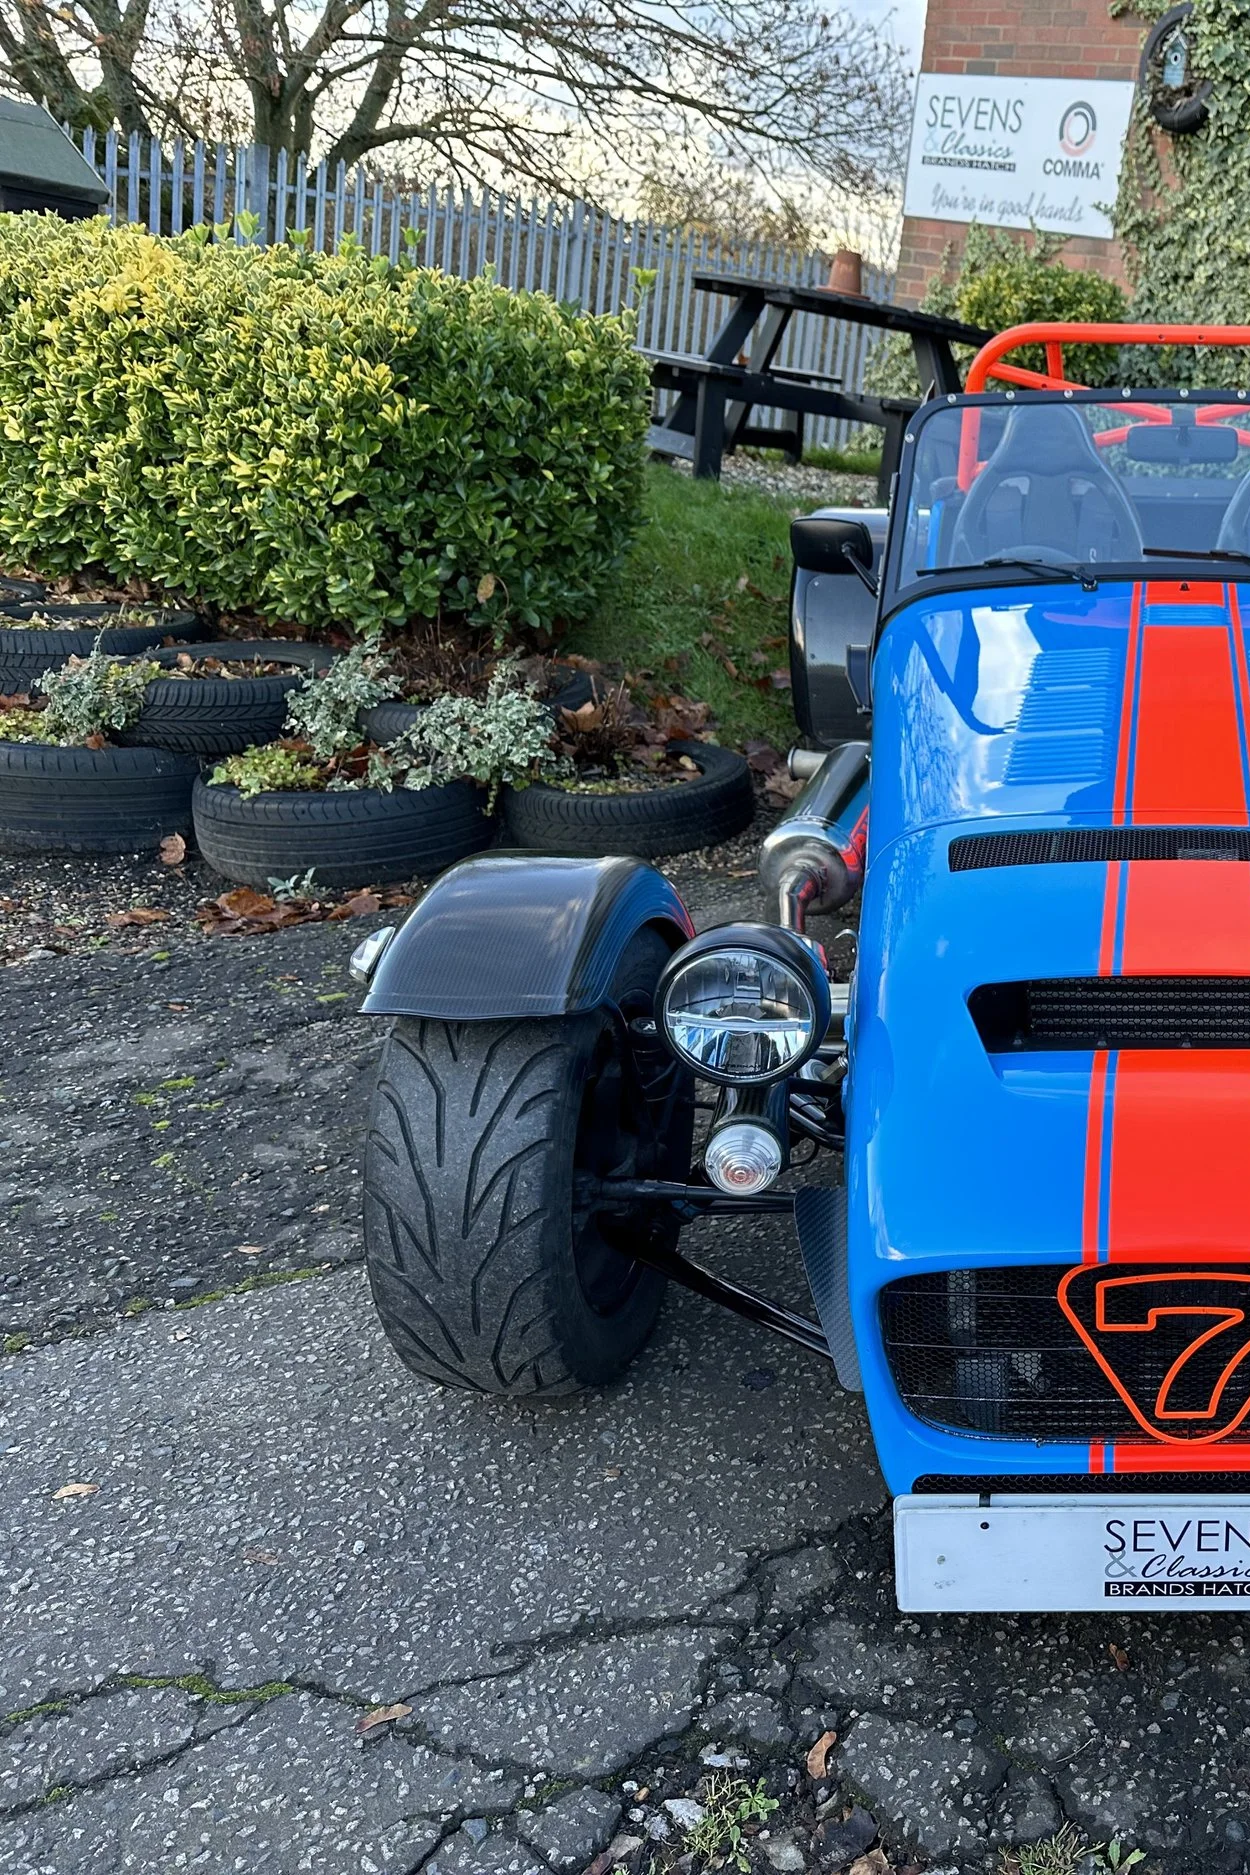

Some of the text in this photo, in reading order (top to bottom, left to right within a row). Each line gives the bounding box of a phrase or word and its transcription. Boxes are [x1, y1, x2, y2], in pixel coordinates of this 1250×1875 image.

[925, 95, 1024, 133] SEVENS
[923, 156, 1015, 172] BRANDS HATCH
[979, 193, 995, 213] in
[997, 192, 1034, 223] good
[1035, 192, 1084, 222] hands
[1109, 1583, 1195, 1596] BRANDS
